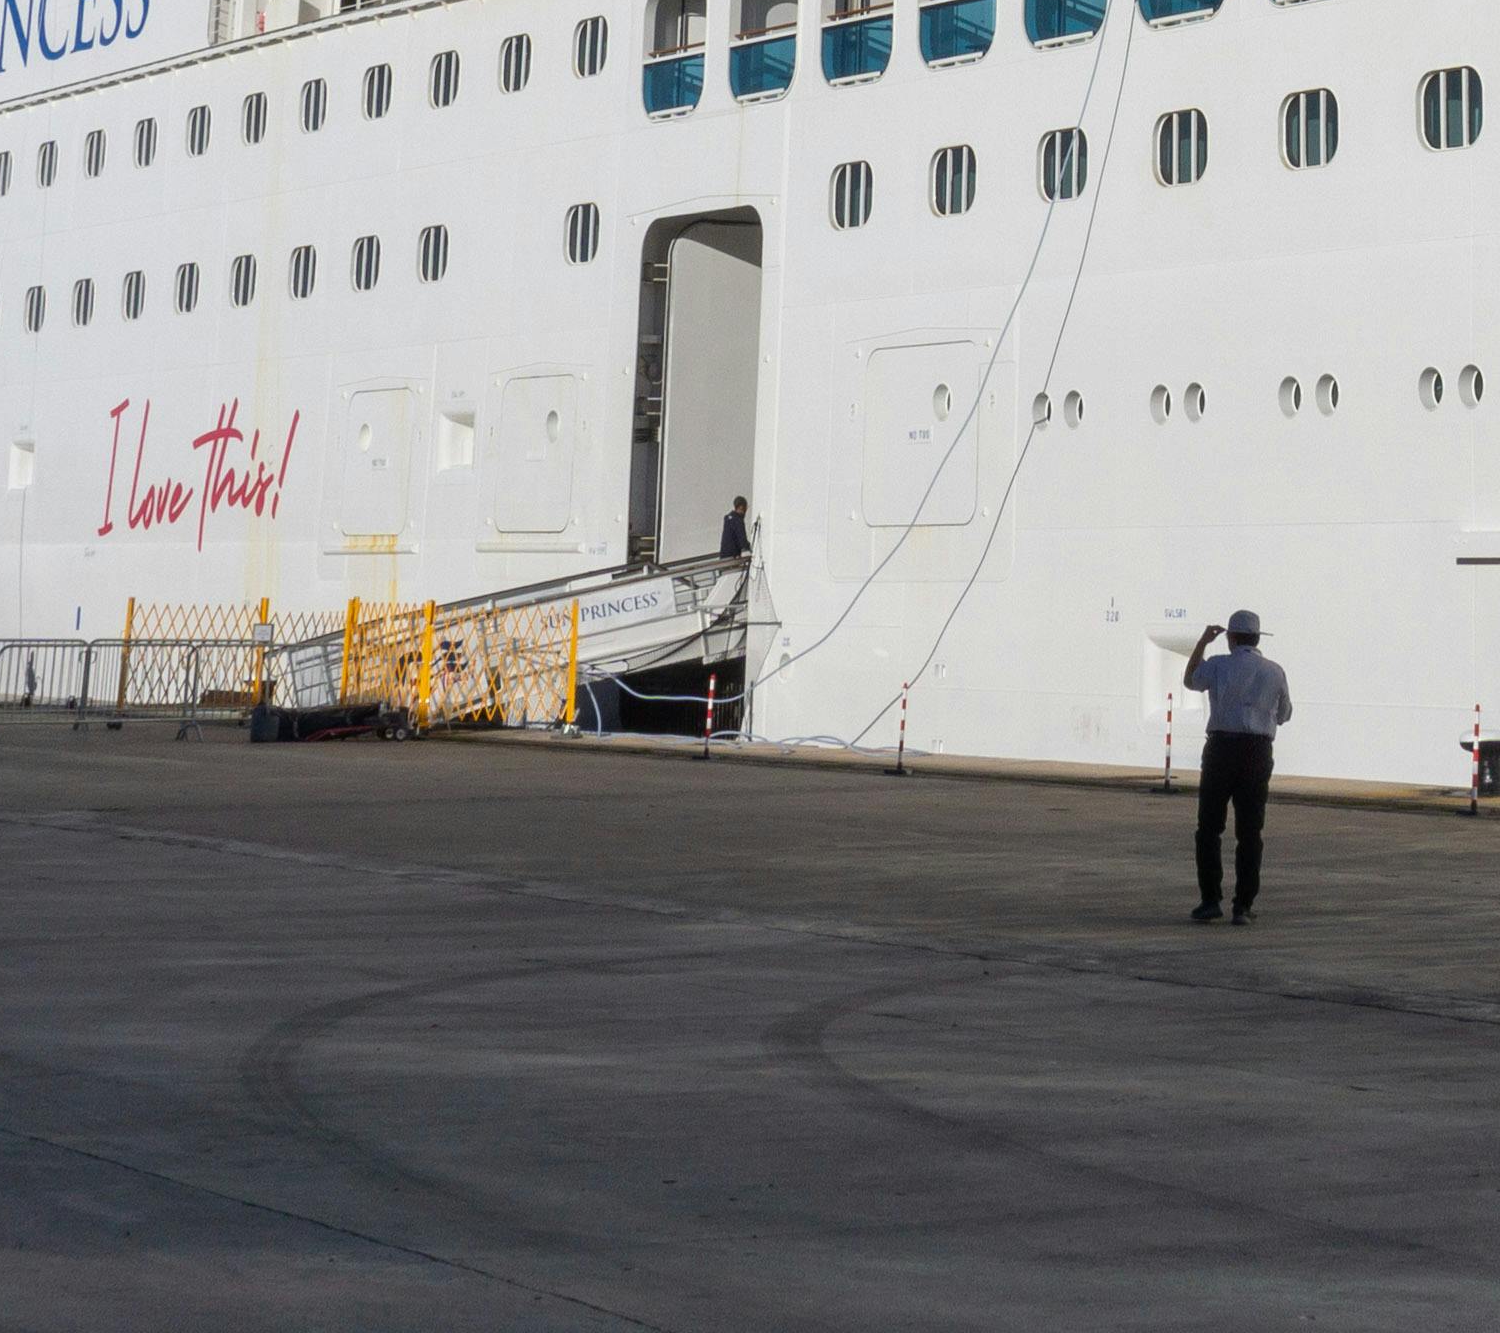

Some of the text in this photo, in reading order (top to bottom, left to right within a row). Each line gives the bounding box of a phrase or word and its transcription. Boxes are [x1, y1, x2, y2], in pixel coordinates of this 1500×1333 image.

[98, 398, 130, 537] I
[128, 398, 194, 530] love
[580, 591, 659, 622] PRINCESS
